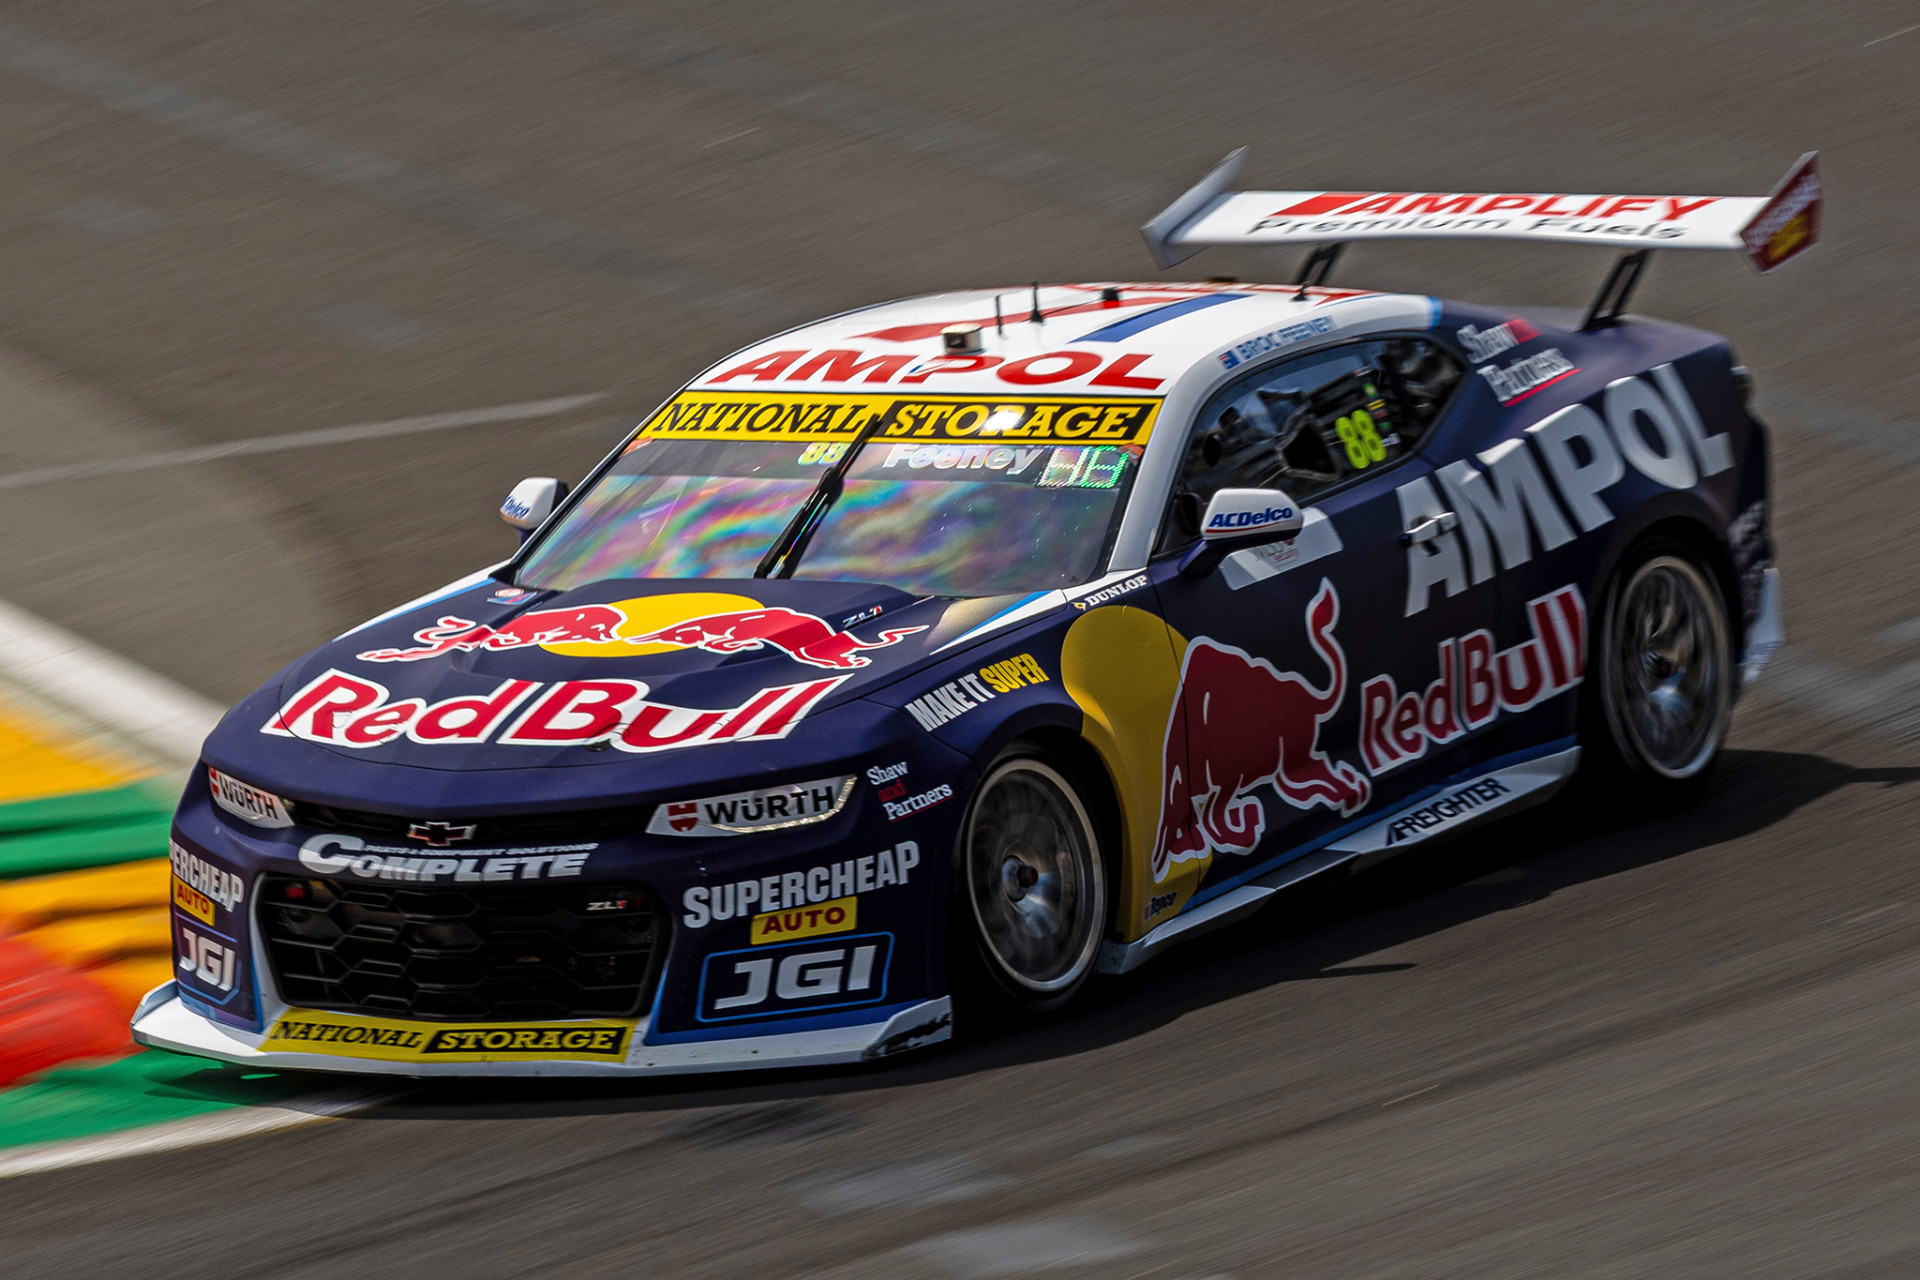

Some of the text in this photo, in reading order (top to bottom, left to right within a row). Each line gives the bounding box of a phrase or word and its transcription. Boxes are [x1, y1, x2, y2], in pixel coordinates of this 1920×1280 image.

[1334, 192, 1726, 221] AMPLIFY
[1247, 216, 1691, 240] Premium Fuels
[706, 350, 1168, 390] AMPOL
[657, 402, 1140, 439] NATIONAL STORAGE
[797, 442, 847, 465] 88
[1335, 410, 1387, 469] 88
[884, 444, 1040, 475] Feeney
[1396, 361, 1736, 618] AMPOL
[1208, 507, 1292, 528] ACDelco
[1085, 575, 1148, 606] DUNLOP
[260, 667, 855, 754] Red Bull
[904, 653, 1050, 732] MAKE IT SUPER
[866, 761, 908, 785] Shaw
[878, 779, 907, 803] and
[705, 784, 834, 825] WÜRTH
[882, 784, 953, 820] Partners
[1387, 777, 1512, 846] FREIGHTER
[298, 833, 591, 882] COMPLETE
[177, 883, 210, 915] AUTO
[682, 840, 920, 929] SUPERCHEAP
[761, 906, 846, 935] AUTO
[179, 926, 237, 992] JGI
[714, 945, 877, 1010] JGI
[275, 1021, 617, 1052] NATIONAL STORAGE
